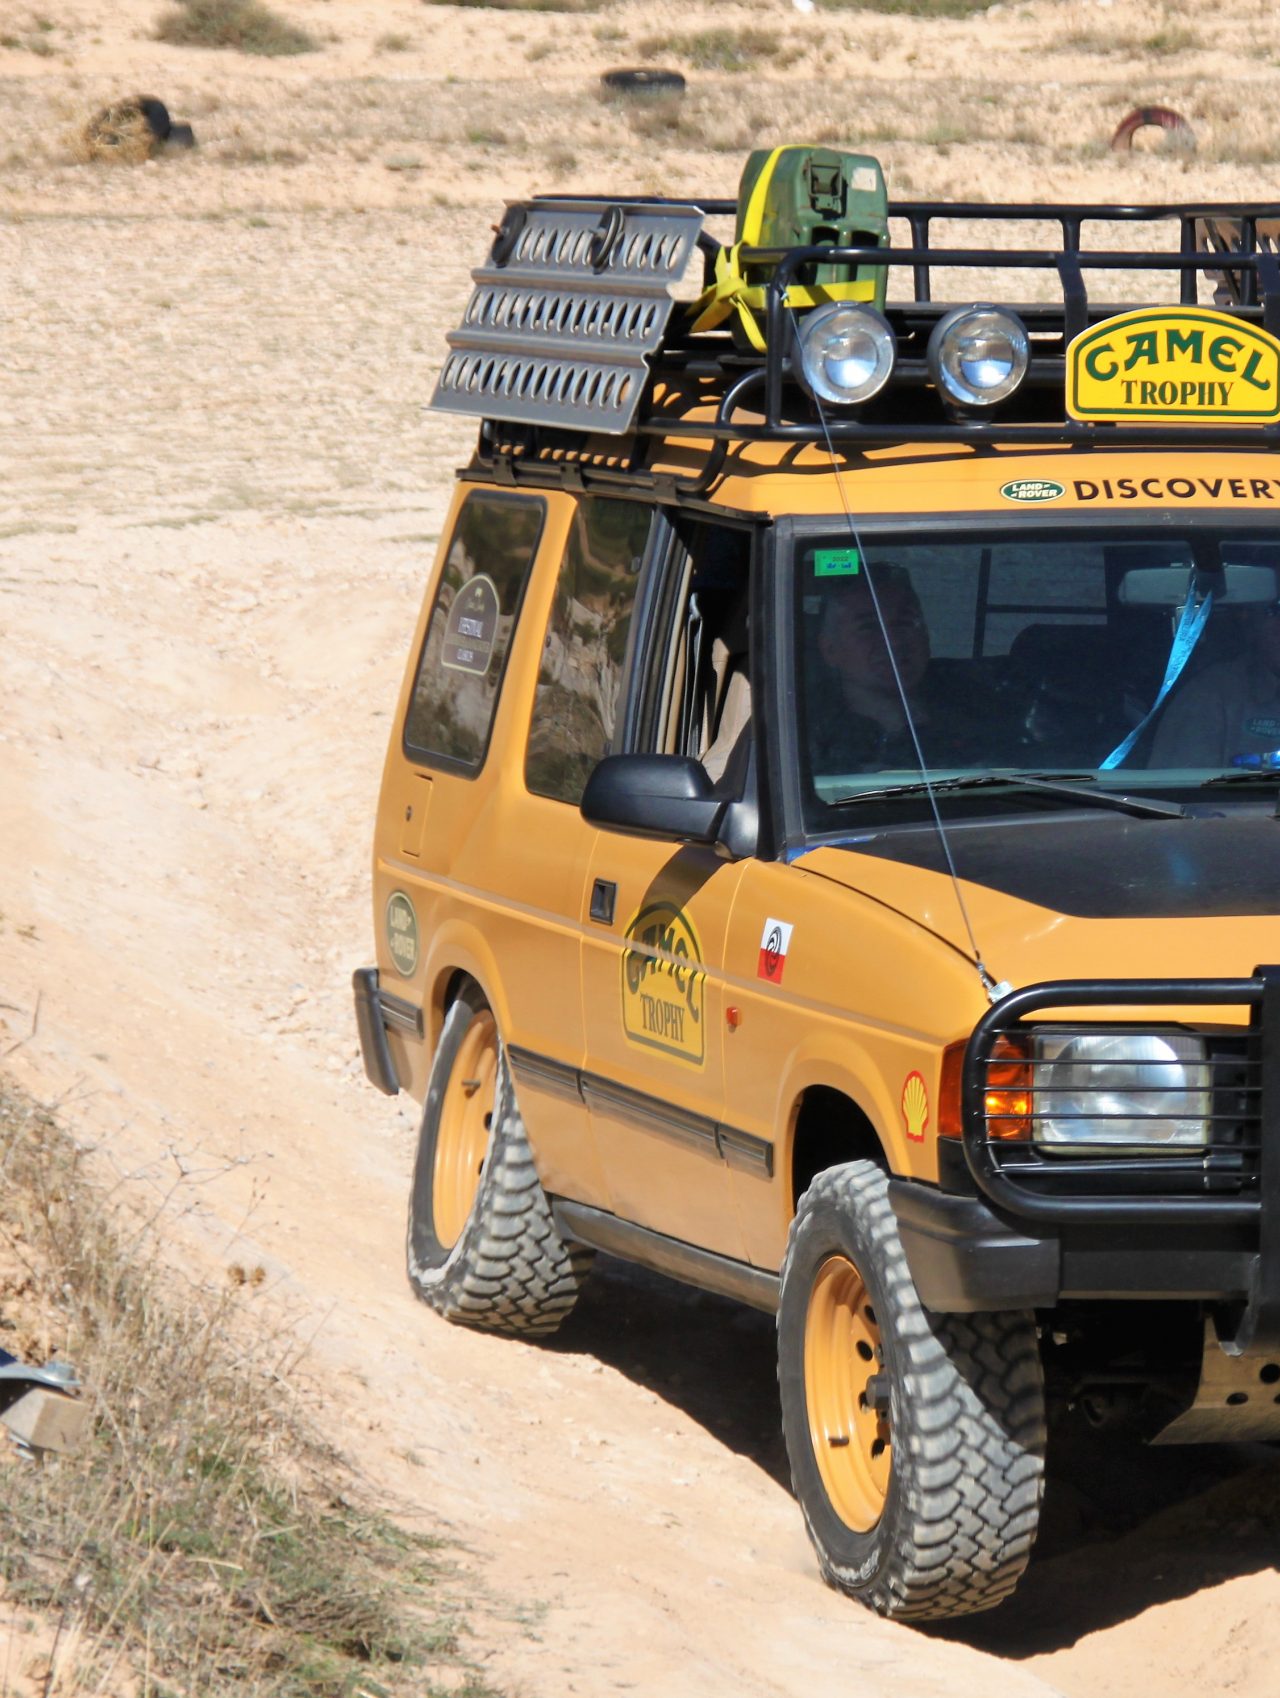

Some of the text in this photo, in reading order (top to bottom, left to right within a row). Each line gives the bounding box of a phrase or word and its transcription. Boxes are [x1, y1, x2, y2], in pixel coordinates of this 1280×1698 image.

[1085, 329, 1271, 391] CAMEL
[1121, 379, 1234, 406] TROPHY
[626, 923, 700, 1023] CAMEL
[640, 993, 686, 1043] TROPHY
